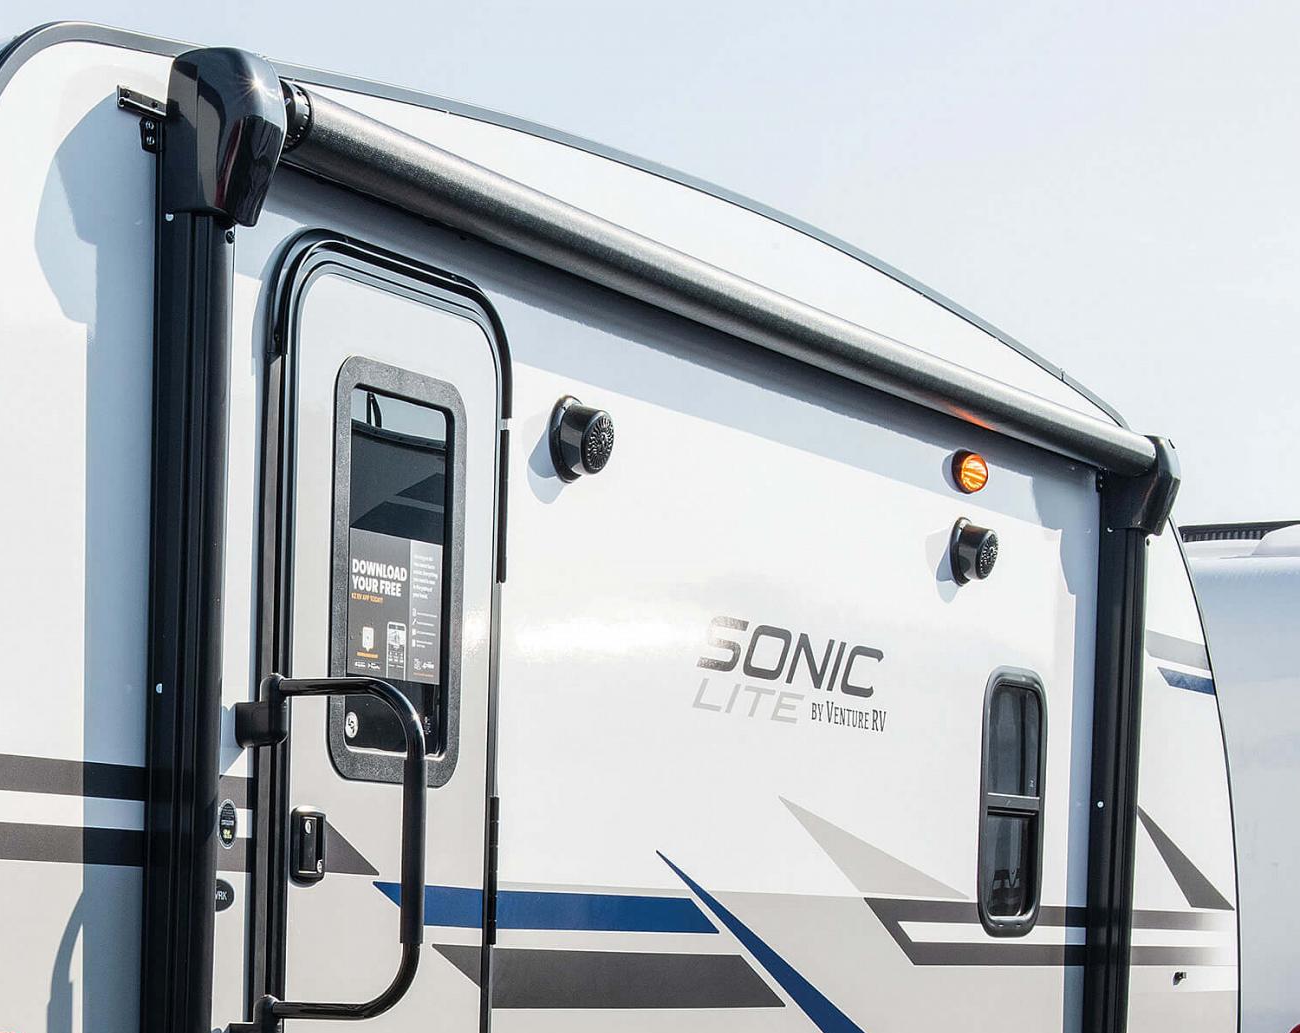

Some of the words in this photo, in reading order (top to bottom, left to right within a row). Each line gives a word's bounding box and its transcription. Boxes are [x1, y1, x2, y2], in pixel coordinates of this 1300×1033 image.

[352, 558, 407, 582] DOWNLOAD
[352, 574, 379, 593] YOUR
[380, 579, 402, 597] FREE
[696, 615, 884, 698] SONIC
[692, 678, 805, 724] LITE
[811, 702, 824, 722] BY
[826, 700, 869, 731] VENTURE
[871, 709, 887, 732] RV
